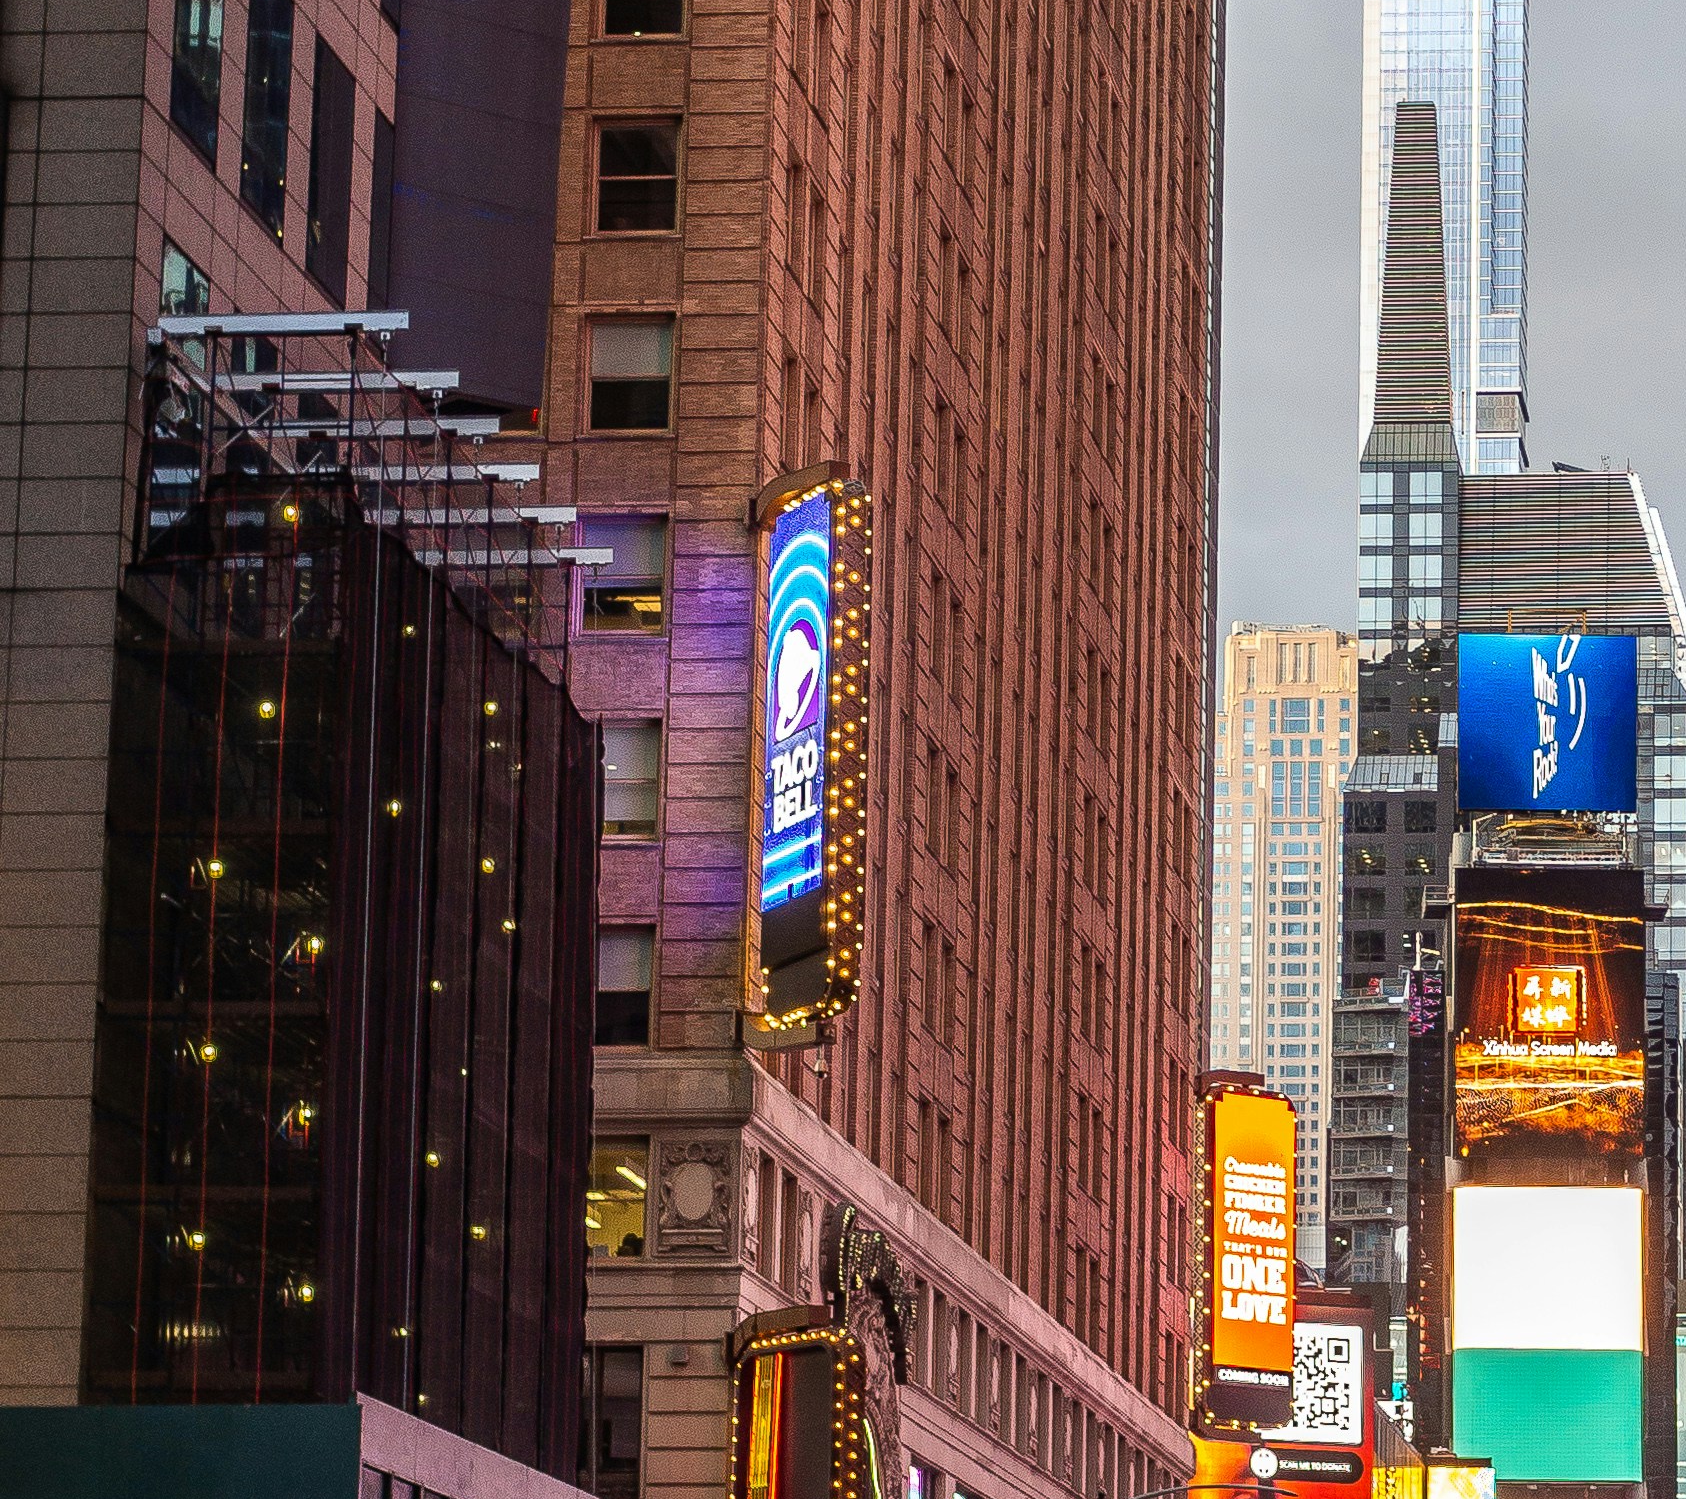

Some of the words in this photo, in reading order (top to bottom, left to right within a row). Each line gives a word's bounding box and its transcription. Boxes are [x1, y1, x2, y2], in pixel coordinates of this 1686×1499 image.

[770, 740, 818, 787] TACO
[773, 780, 818, 835] BELL
[1483, 1040, 1529, 1056] Xinhua
[1531, 1040, 1575, 1056] Screen
[1577, 1040, 1618, 1057] Media
[1221, 1253, 1287, 1294] ONE
[1220, 1290, 1288, 1326] LOVE
